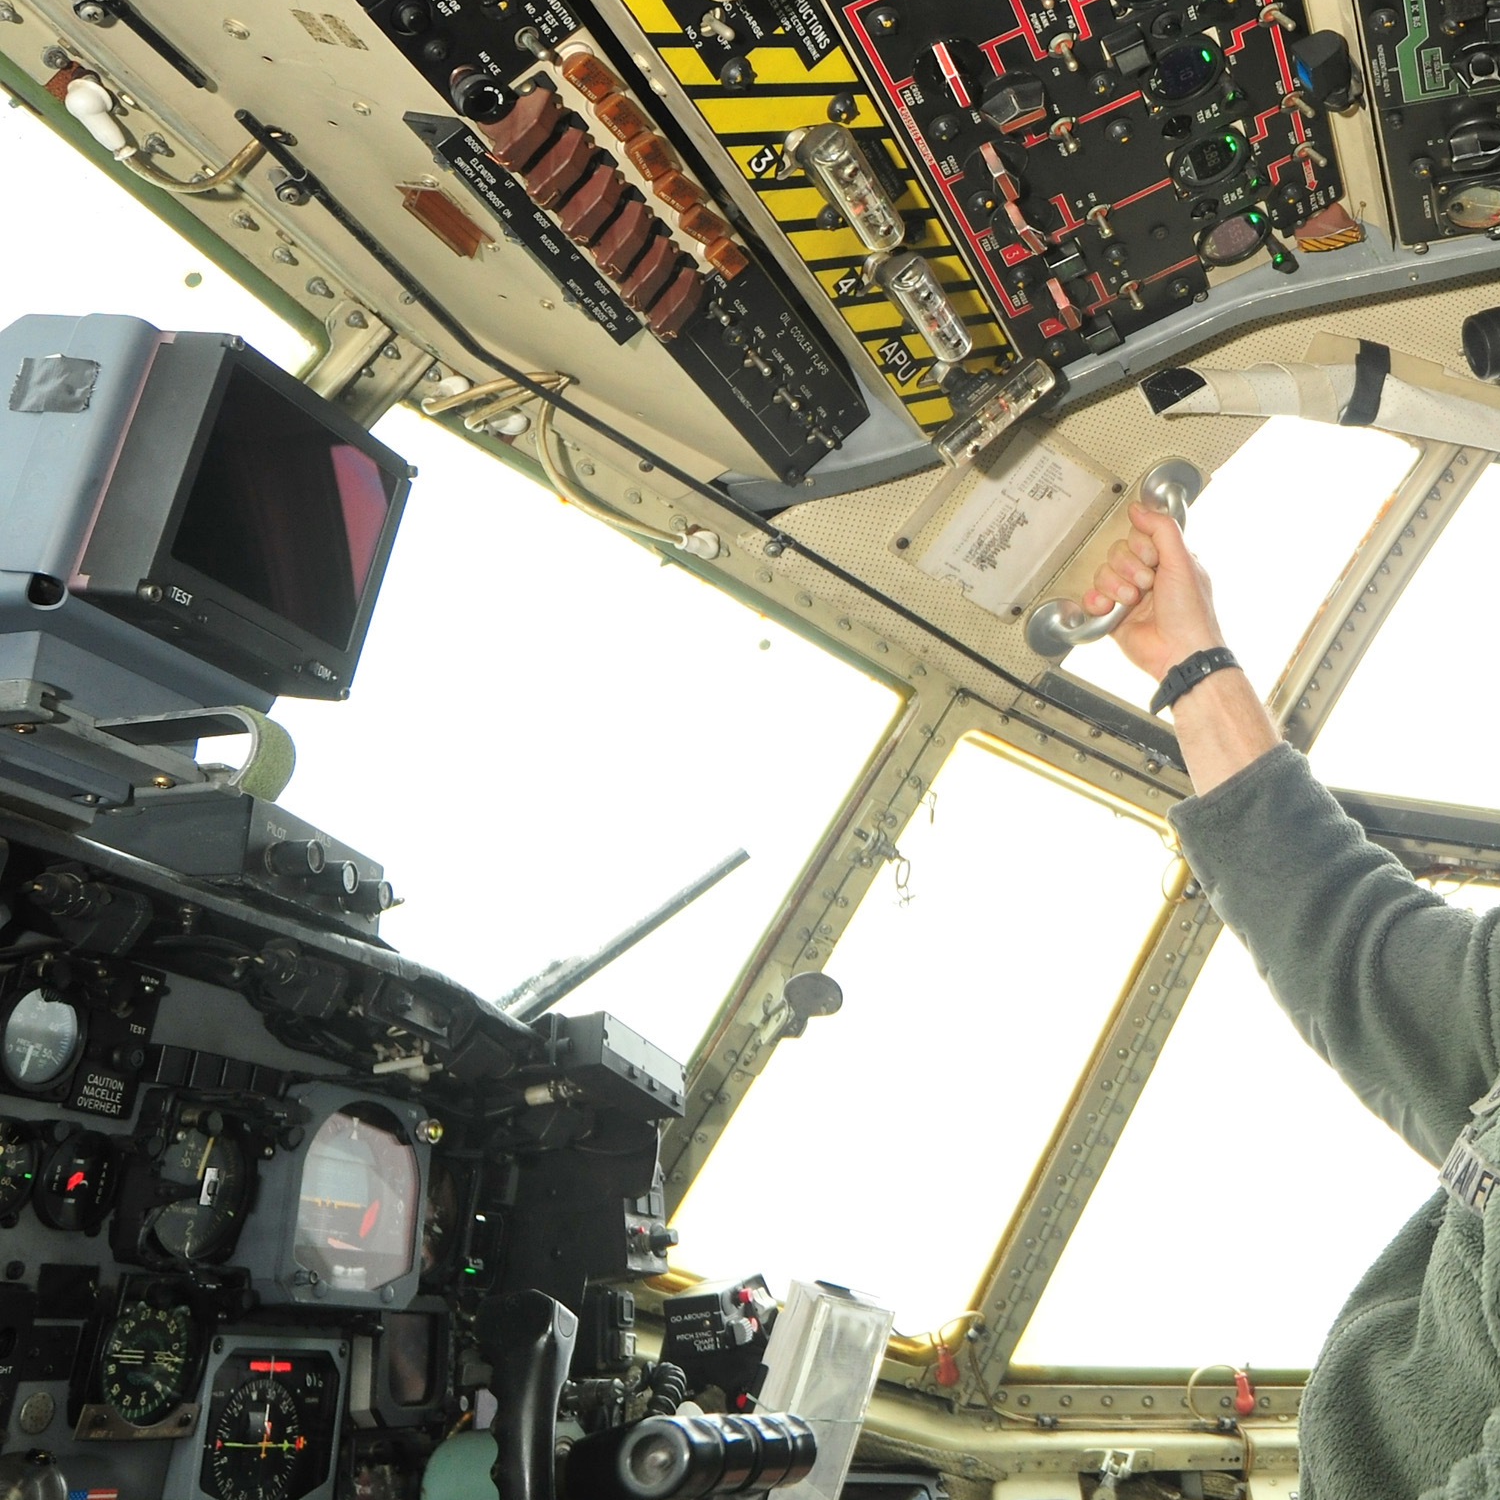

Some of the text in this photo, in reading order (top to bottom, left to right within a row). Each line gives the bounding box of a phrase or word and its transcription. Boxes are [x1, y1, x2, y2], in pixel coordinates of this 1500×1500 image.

[802, 34, 820, 61] ENGINE
[477, 50, 502, 76] NO ICE
[453, 156, 477, 181] SWITCH
[468, 157, 497, 186] ELEVATOR
[749, 152, 770, 175] 3
[538, 233, 560, 256] RUDDER
[835, 276, 854, 295] 4
[779, 311, 830, 377] OIL COOLER FLAPS
[878, 339, 913, 383] APU
[169, 585, 194, 607] TEST
[129, 1023, 146, 1035] TEST
[82, 1085, 122, 1103] NACELLE
[87, 1074, 124, 1091] CAUTION
[77, 1097, 122, 1115] OVERHEAT
[684, 1311, 711, 1320] AROUND
